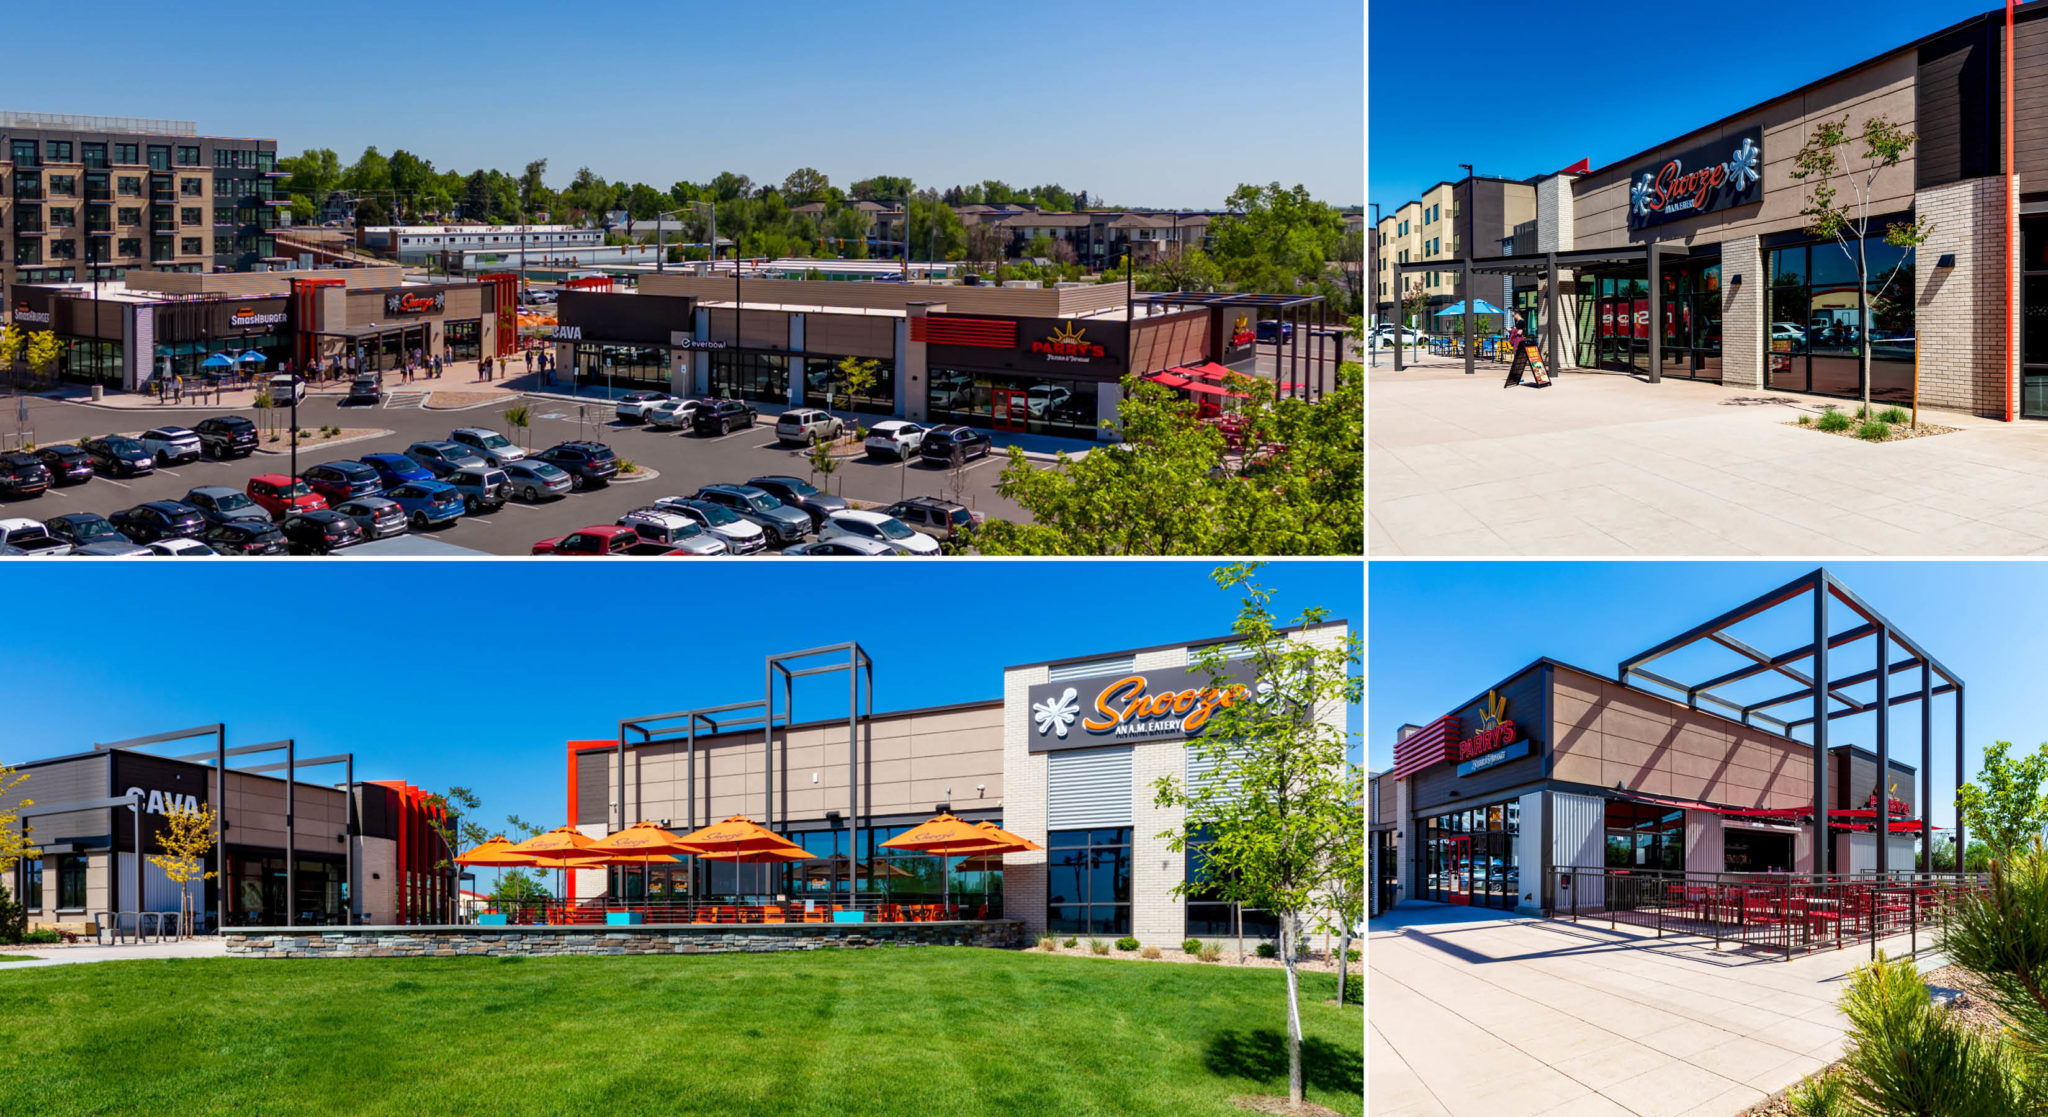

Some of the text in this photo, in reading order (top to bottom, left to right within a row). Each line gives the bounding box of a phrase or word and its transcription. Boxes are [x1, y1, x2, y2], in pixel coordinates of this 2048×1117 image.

[1650, 160, 1727, 210] Snooze
[552, 325, 582, 340] CAVA
[691, 341, 727, 349] everbowl
[1032, 341, 1105, 357] PARRY'S
[1082, 675, 1251, 734] Snooze
[1115, 720, 1181, 735] AN A.M. EATERY
[1459, 719, 1517, 761] PARRY'S
